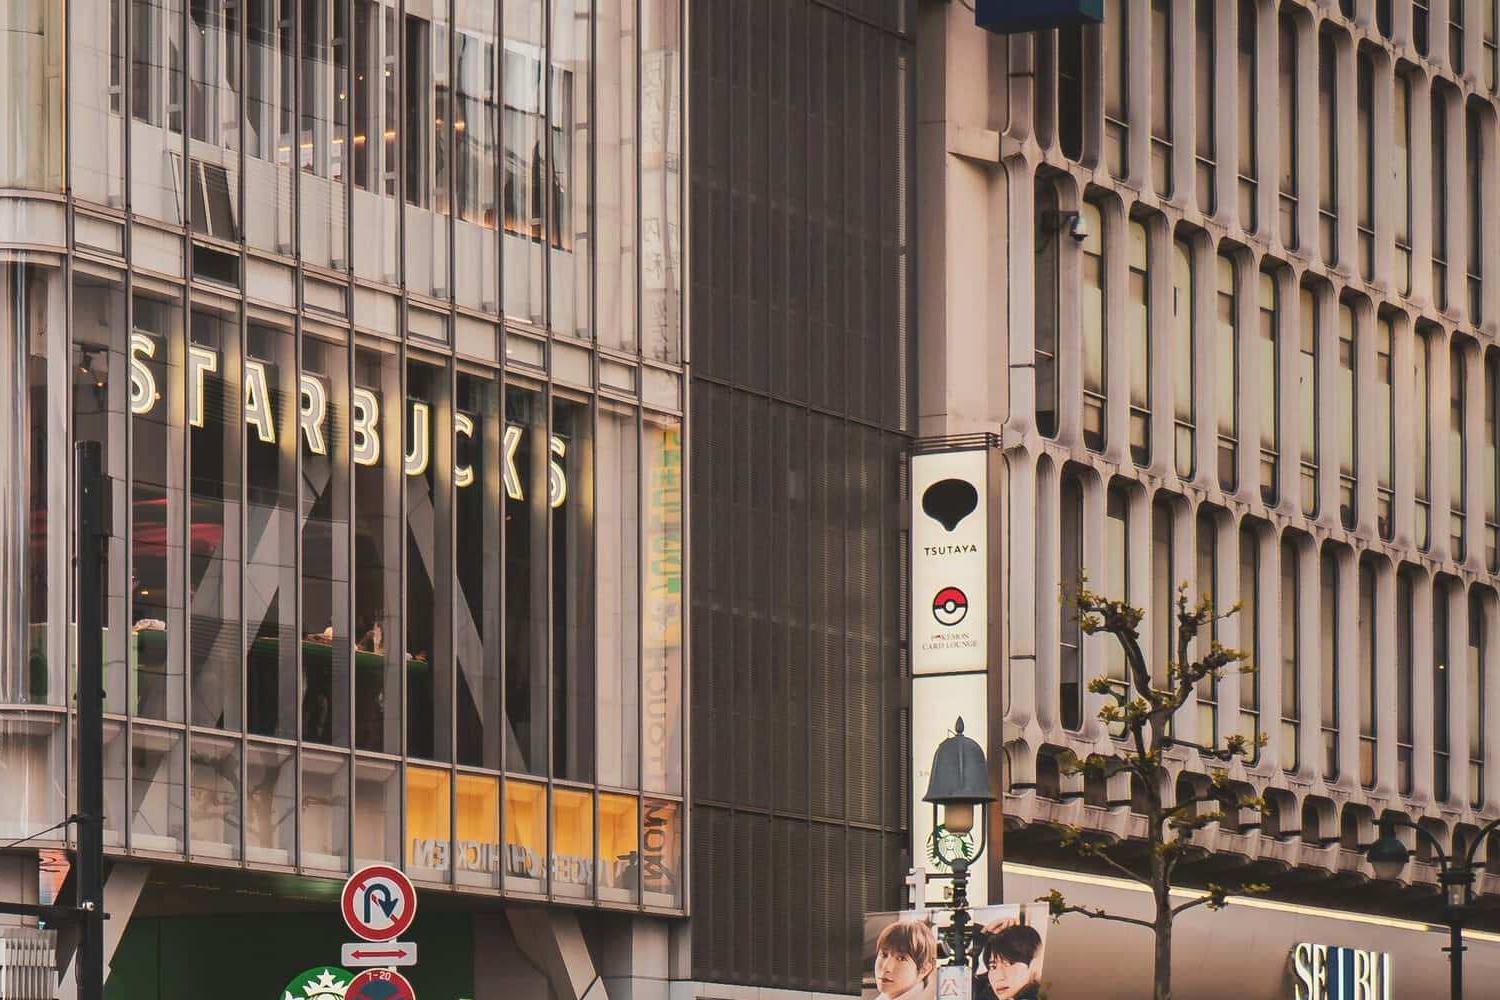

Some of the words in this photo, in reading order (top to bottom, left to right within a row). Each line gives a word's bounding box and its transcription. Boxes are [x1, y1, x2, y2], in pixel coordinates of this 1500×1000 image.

[131, 333, 567, 508] STARBUCKS
[924, 543, 978, 556] TSUTAYA
[367, 971, 391, 981] 7-20
